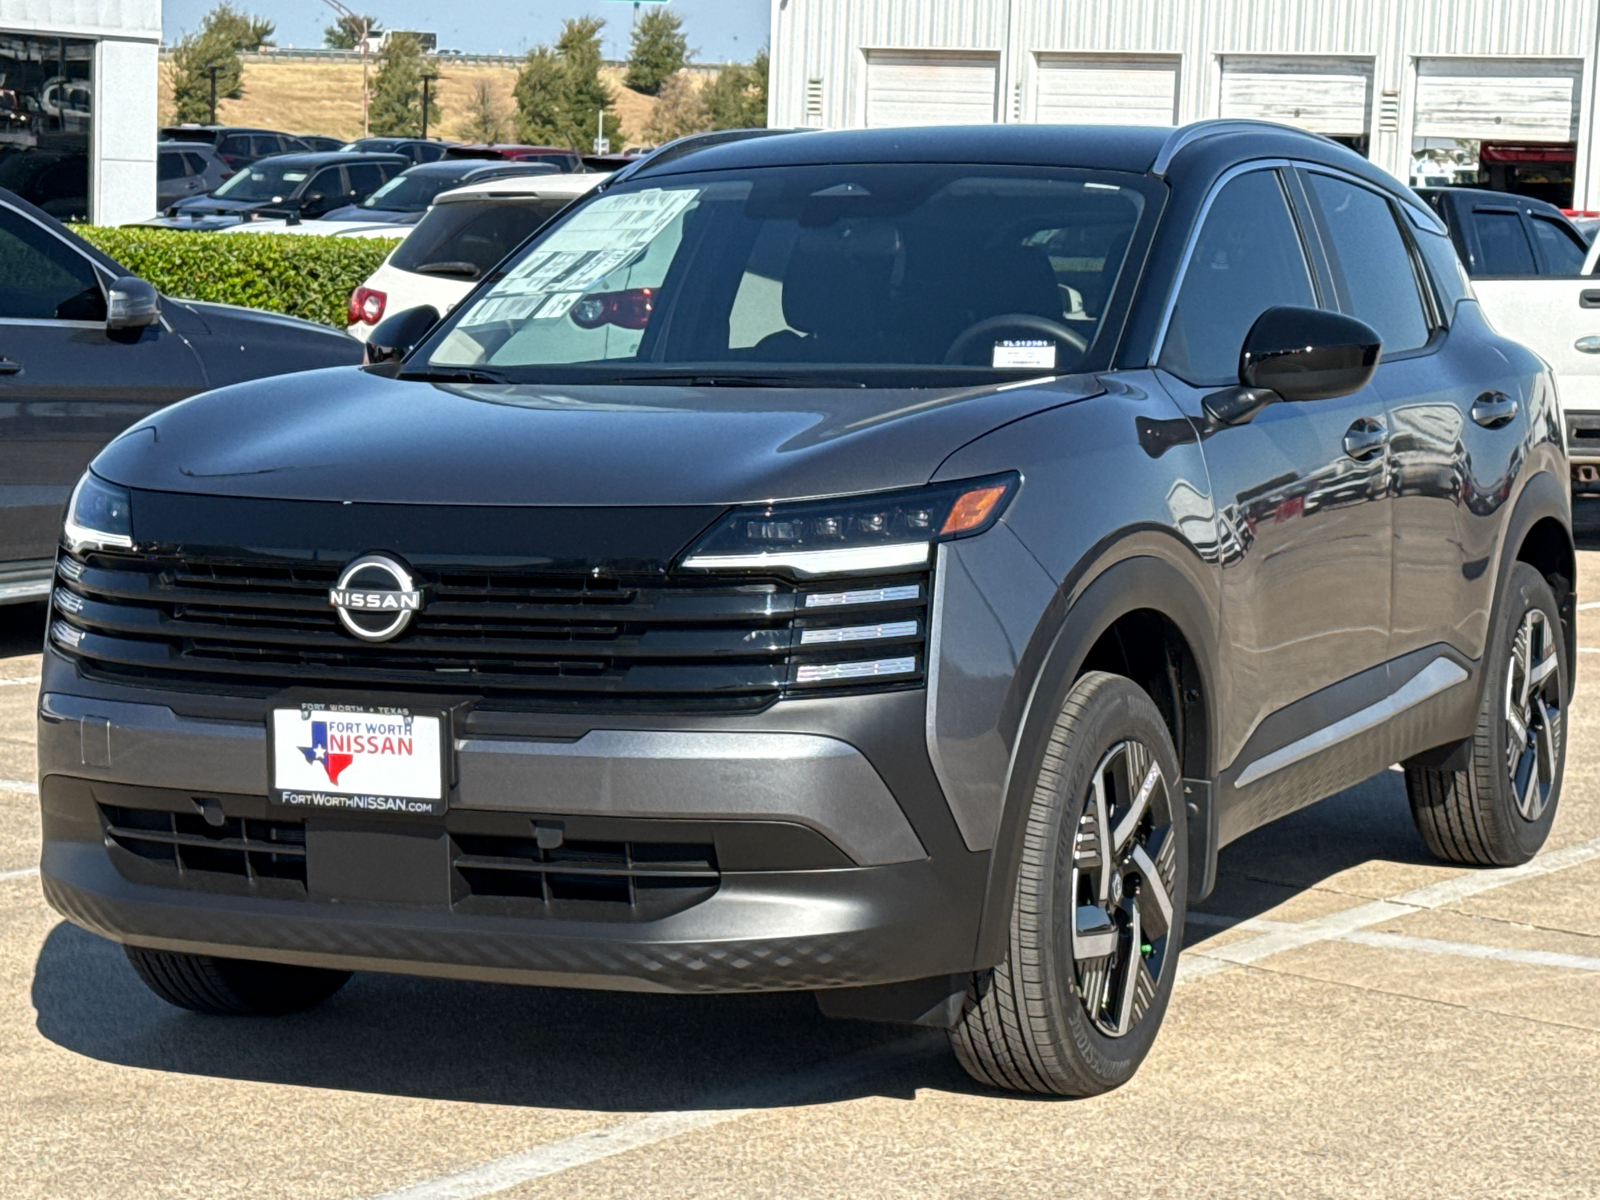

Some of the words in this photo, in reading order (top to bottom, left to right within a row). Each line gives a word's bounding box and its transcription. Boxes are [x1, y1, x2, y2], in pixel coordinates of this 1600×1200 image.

[330, 590, 417, 608] NISSAN
[301, 703, 325, 711] FORT
[329, 704, 364, 713] WORTH
[378, 706, 409, 715] TEXAS
[329, 721, 362, 734] FORT
[365, 723, 412, 736] WORTH
[330, 734, 413, 756] NISSAN
